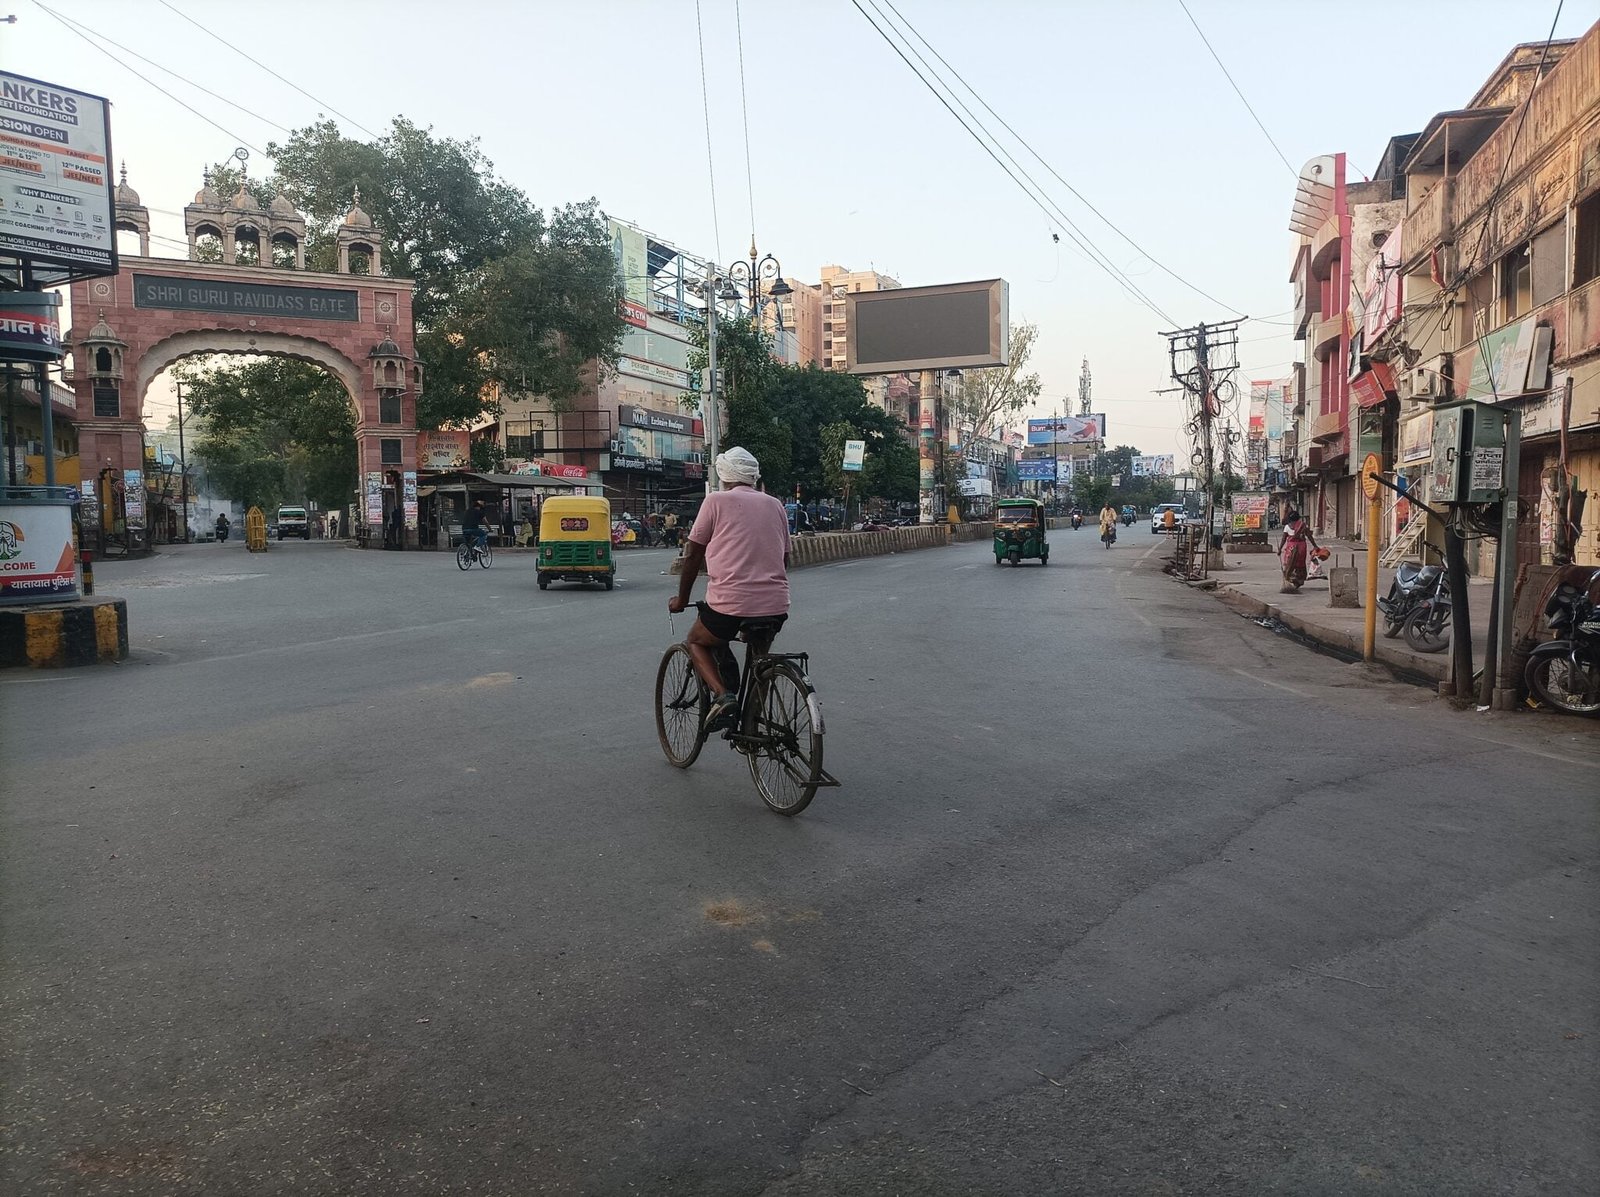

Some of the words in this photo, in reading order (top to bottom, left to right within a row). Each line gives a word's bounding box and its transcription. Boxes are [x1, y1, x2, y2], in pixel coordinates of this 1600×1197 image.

[0, 80, 77, 114] NKERS
[19, 103, 75, 123] FOUNDATION
[34, 127, 64, 140] OPEN
[66, 150, 90, 160] TARGET
[1, 158, 38, 171] JEE/NEET
[75, 164, 101, 175] PASSED
[67, 171, 100, 184] JEE/NEET
[20, 187, 39, 197] WHY
[15, 221, 45, 231] COACHING
[56, 228, 80, 238] GROWTH
[7, 237, 26, 245] MORE
[26, 240, 51, 250] DETAILS
[56, 244, 71, 253] CALL
[147, 285, 182, 301] SHRI
[188, 288, 228, 305] GURU
[233, 291, 304, 311] RAVIDASS
[309, 297, 347, 314] GATE
[0, 561, 36, 571] COME
[11, 579, 50, 590] यातायात
[51, 575, 70, 591] पुलिस
